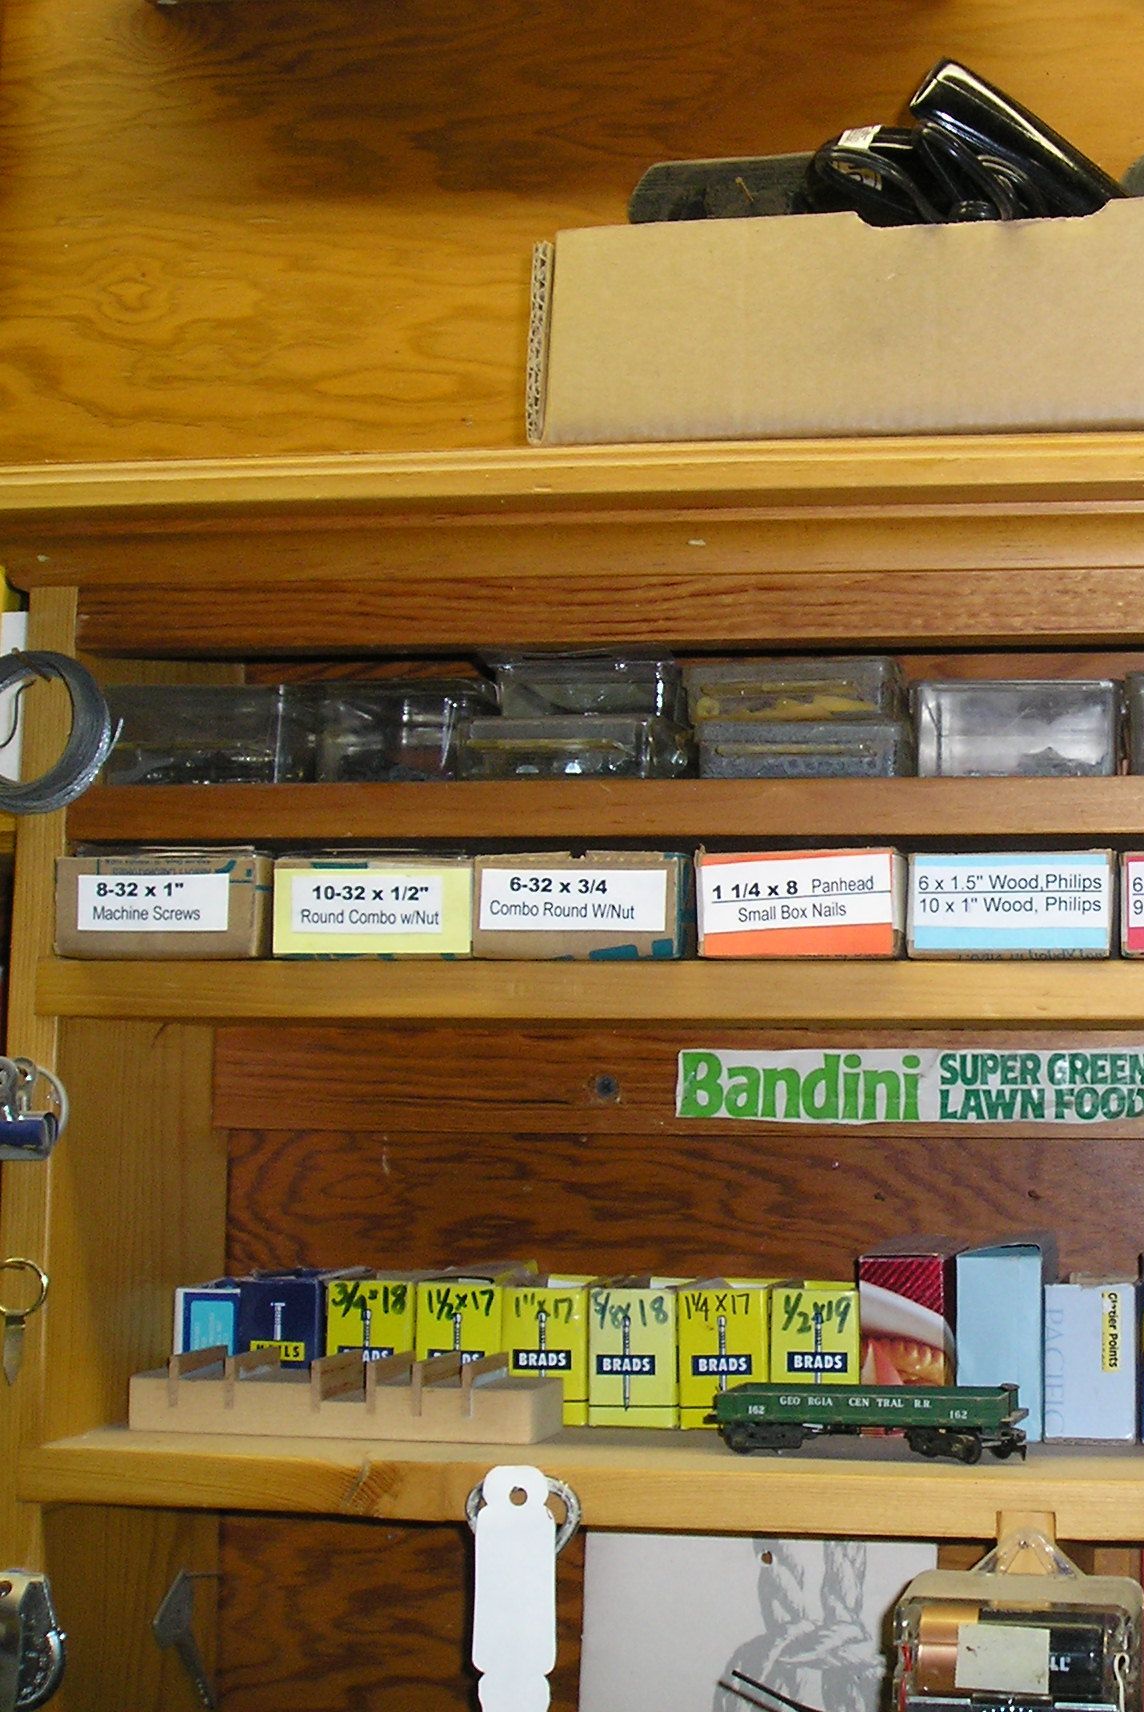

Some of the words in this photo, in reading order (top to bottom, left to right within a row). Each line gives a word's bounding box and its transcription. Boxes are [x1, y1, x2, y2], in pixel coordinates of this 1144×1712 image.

[96, 882, 138, 897] 8-32
[145, 886, 156, 897] x
[163, 882, 184, 897] 1"
[509, 876, 553, 893] 6-32
[559, 881, 571, 893] x
[578, 879, 608, 894] 3/4
[731, 882, 761, 898] 1/4
[767, 884, 779, 896] x
[786, 880, 798, 895] 8
[811, 875, 875, 893] Panhead
[918, 875, 929, 891] 6
[935, 879, 944, 891] x
[951, 874, 983, 890] 1.5"
[1132, 877, 1143, 892] 6
[312, 885, 366, 901] 10-32
[372, 889, 383, 901] x
[390, 886, 429, 901] 1/2"
[93, 905, 149, 920] Machine
[153, 905, 201, 921] Screws
[490, 900, 540, 916] Combo
[543, 902, 588, 918] Round
[592, 903, 635, 919] W/Nut
[738, 906, 776, 922] Small
[781, 904, 808, 920] Box
[812, 901, 847, 918] Nails
[919, 897, 940, 913] 10
[945, 901, 954, 912] x
[962, 897, 978, 912] 1"
[984, 897, 1039, 914] Wood,
[1045, 896, 1102, 914] Philips
[1133, 899, 1143, 915] 9
[301, 909, 344, 924] Round
[348, 909, 397, 925] Combo
[401, 910, 440, 925] w/Nut
[939, 1052, 1041, 1086] SUPER
[679, 1051, 921, 1120] Bandini
[939, 1087, 1045, 1121] LAWN
[1108, 1333, 1119, 1368] Points
[518, 1352, 567, 1367] BRADS
[602, 1357, 651, 1373] BRADS
[698, 1357, 748, 1373] BRADS
[793, 1355, 843, 1370] BRADS
[949, 1409, 968, 1419] 162
